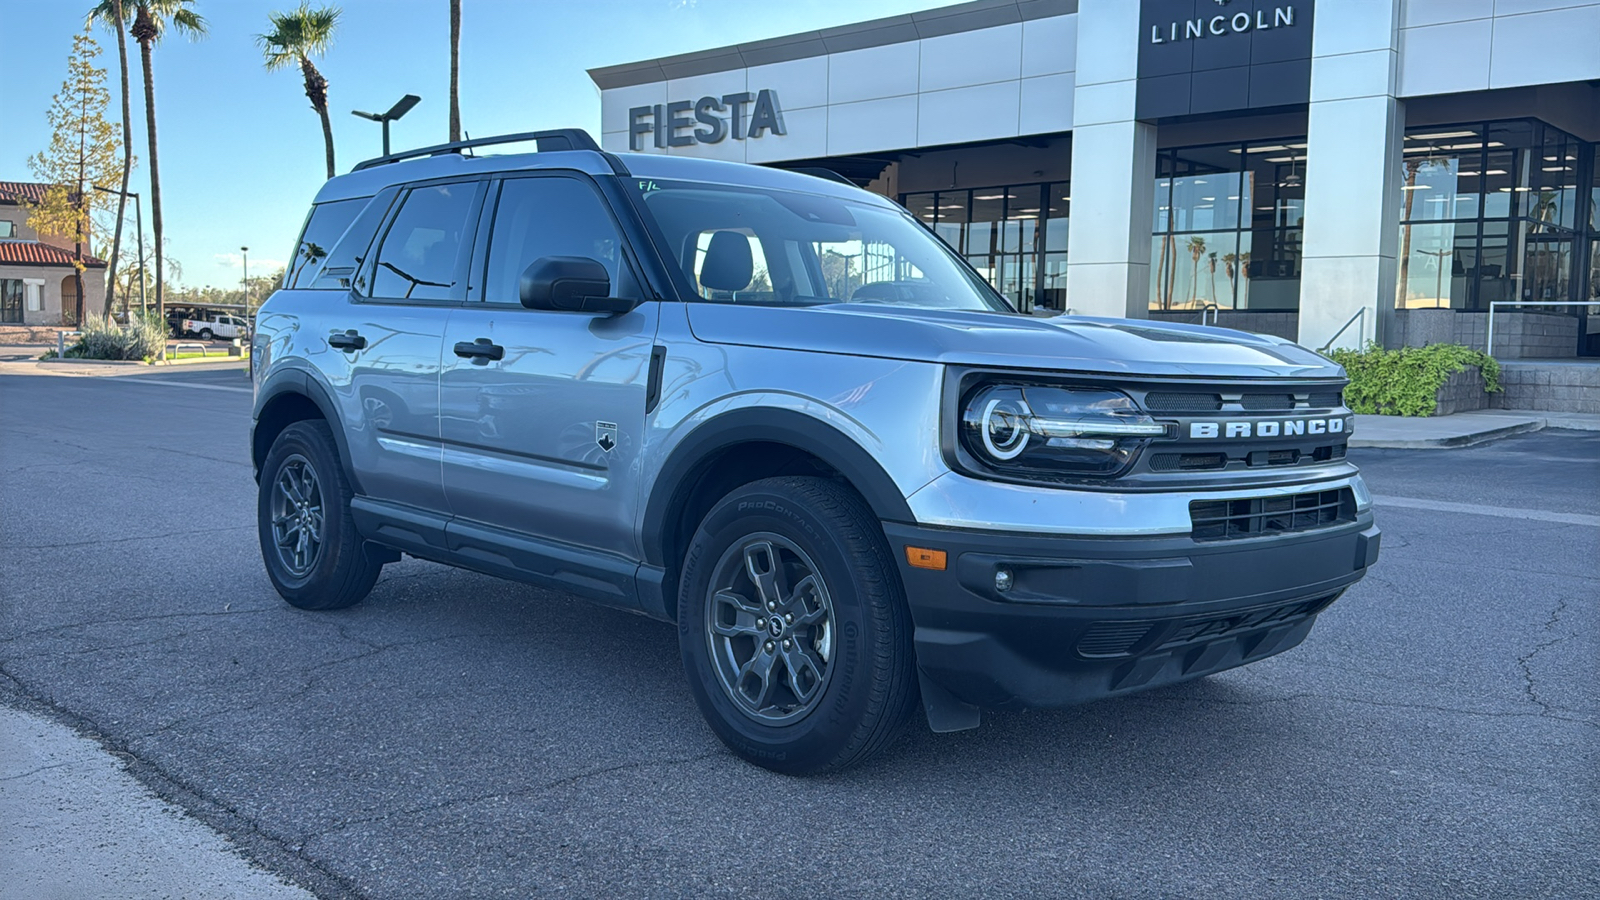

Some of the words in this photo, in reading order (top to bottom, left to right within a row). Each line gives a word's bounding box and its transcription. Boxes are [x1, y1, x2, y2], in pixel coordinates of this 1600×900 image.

[1152, 6, 1294, 43] LINCOLN
[629, 89, 787, 150] FIESTA
[1190, 419, 1343, 438] BRONCO
